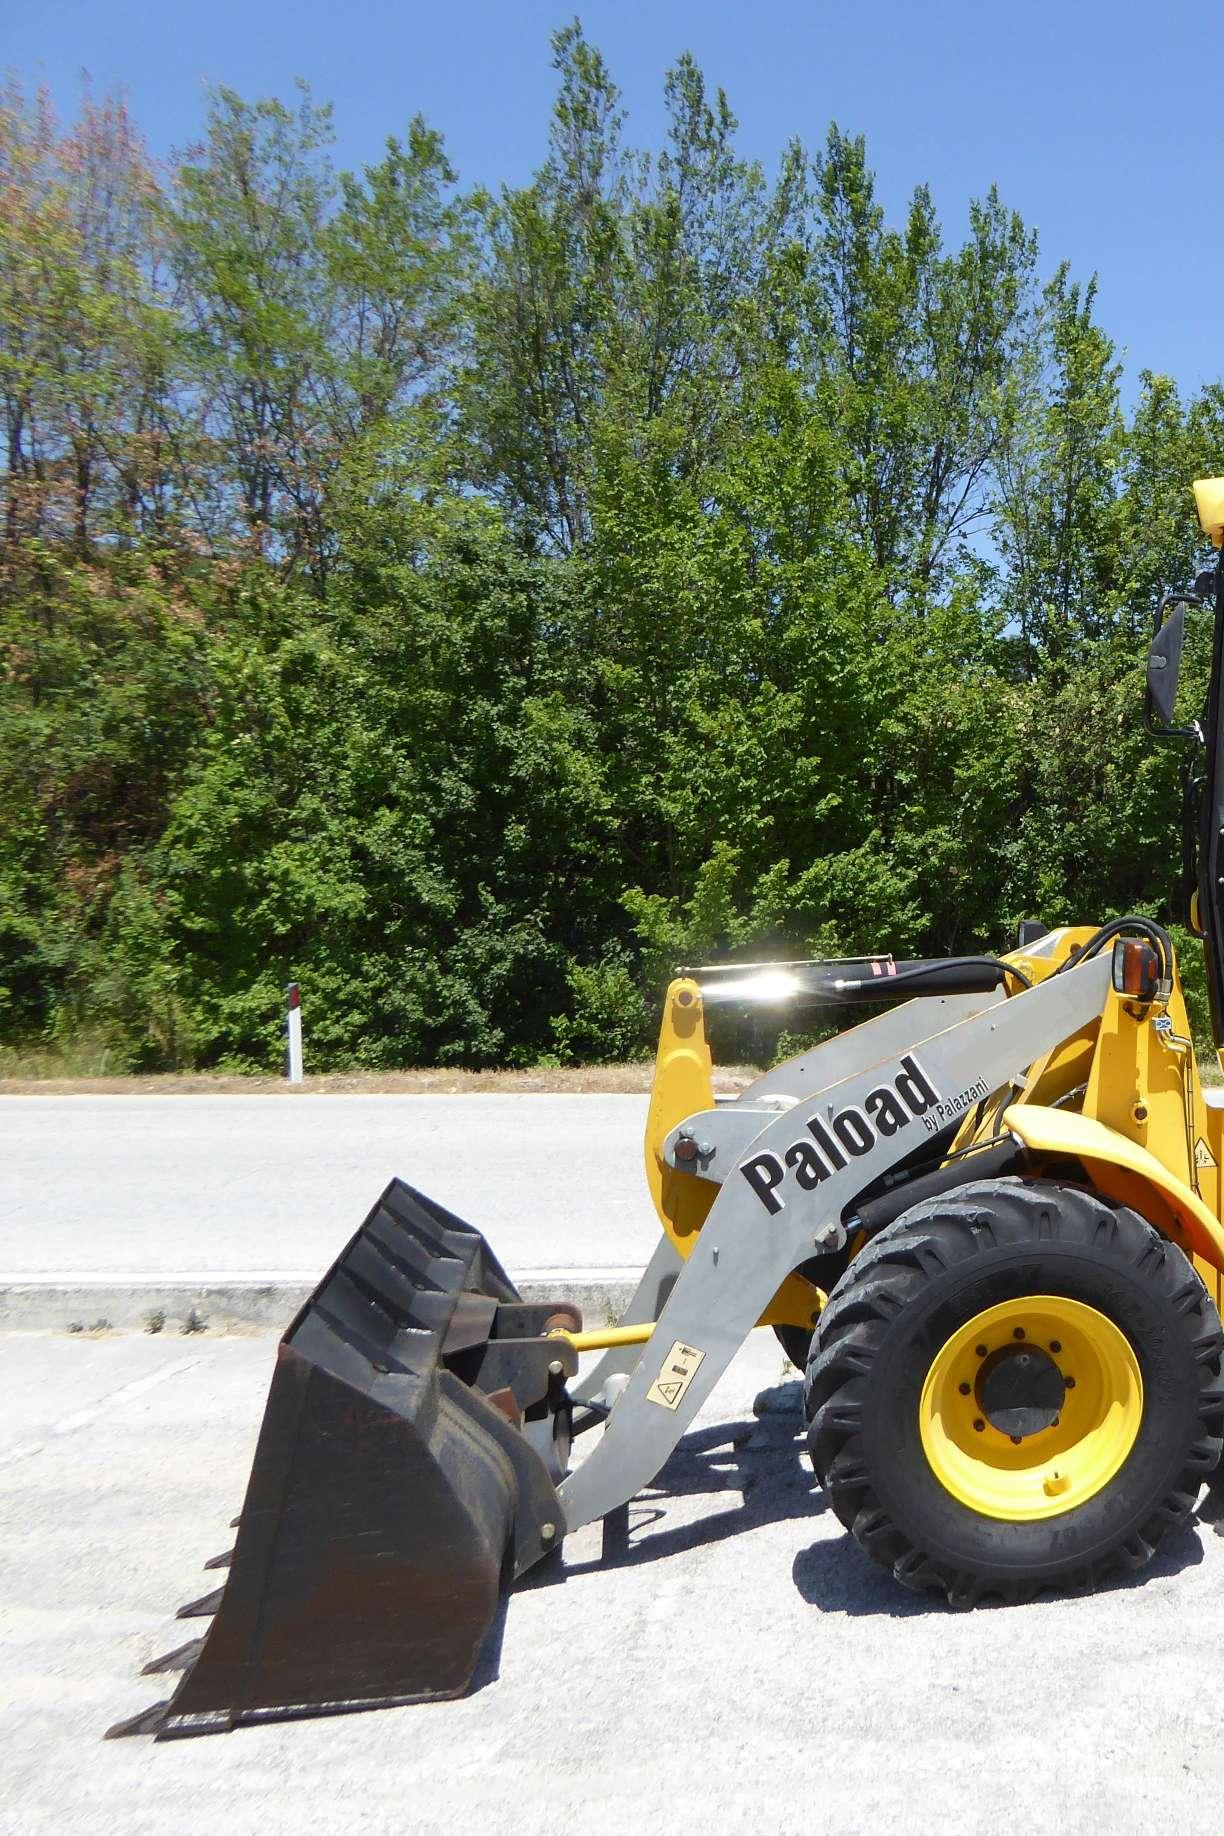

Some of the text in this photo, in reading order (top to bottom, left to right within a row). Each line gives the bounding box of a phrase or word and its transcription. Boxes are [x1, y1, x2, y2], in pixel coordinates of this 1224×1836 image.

[740, 1052, 941, 1216] Paload
[921, 1076, 989, 1132] by Palazzani
